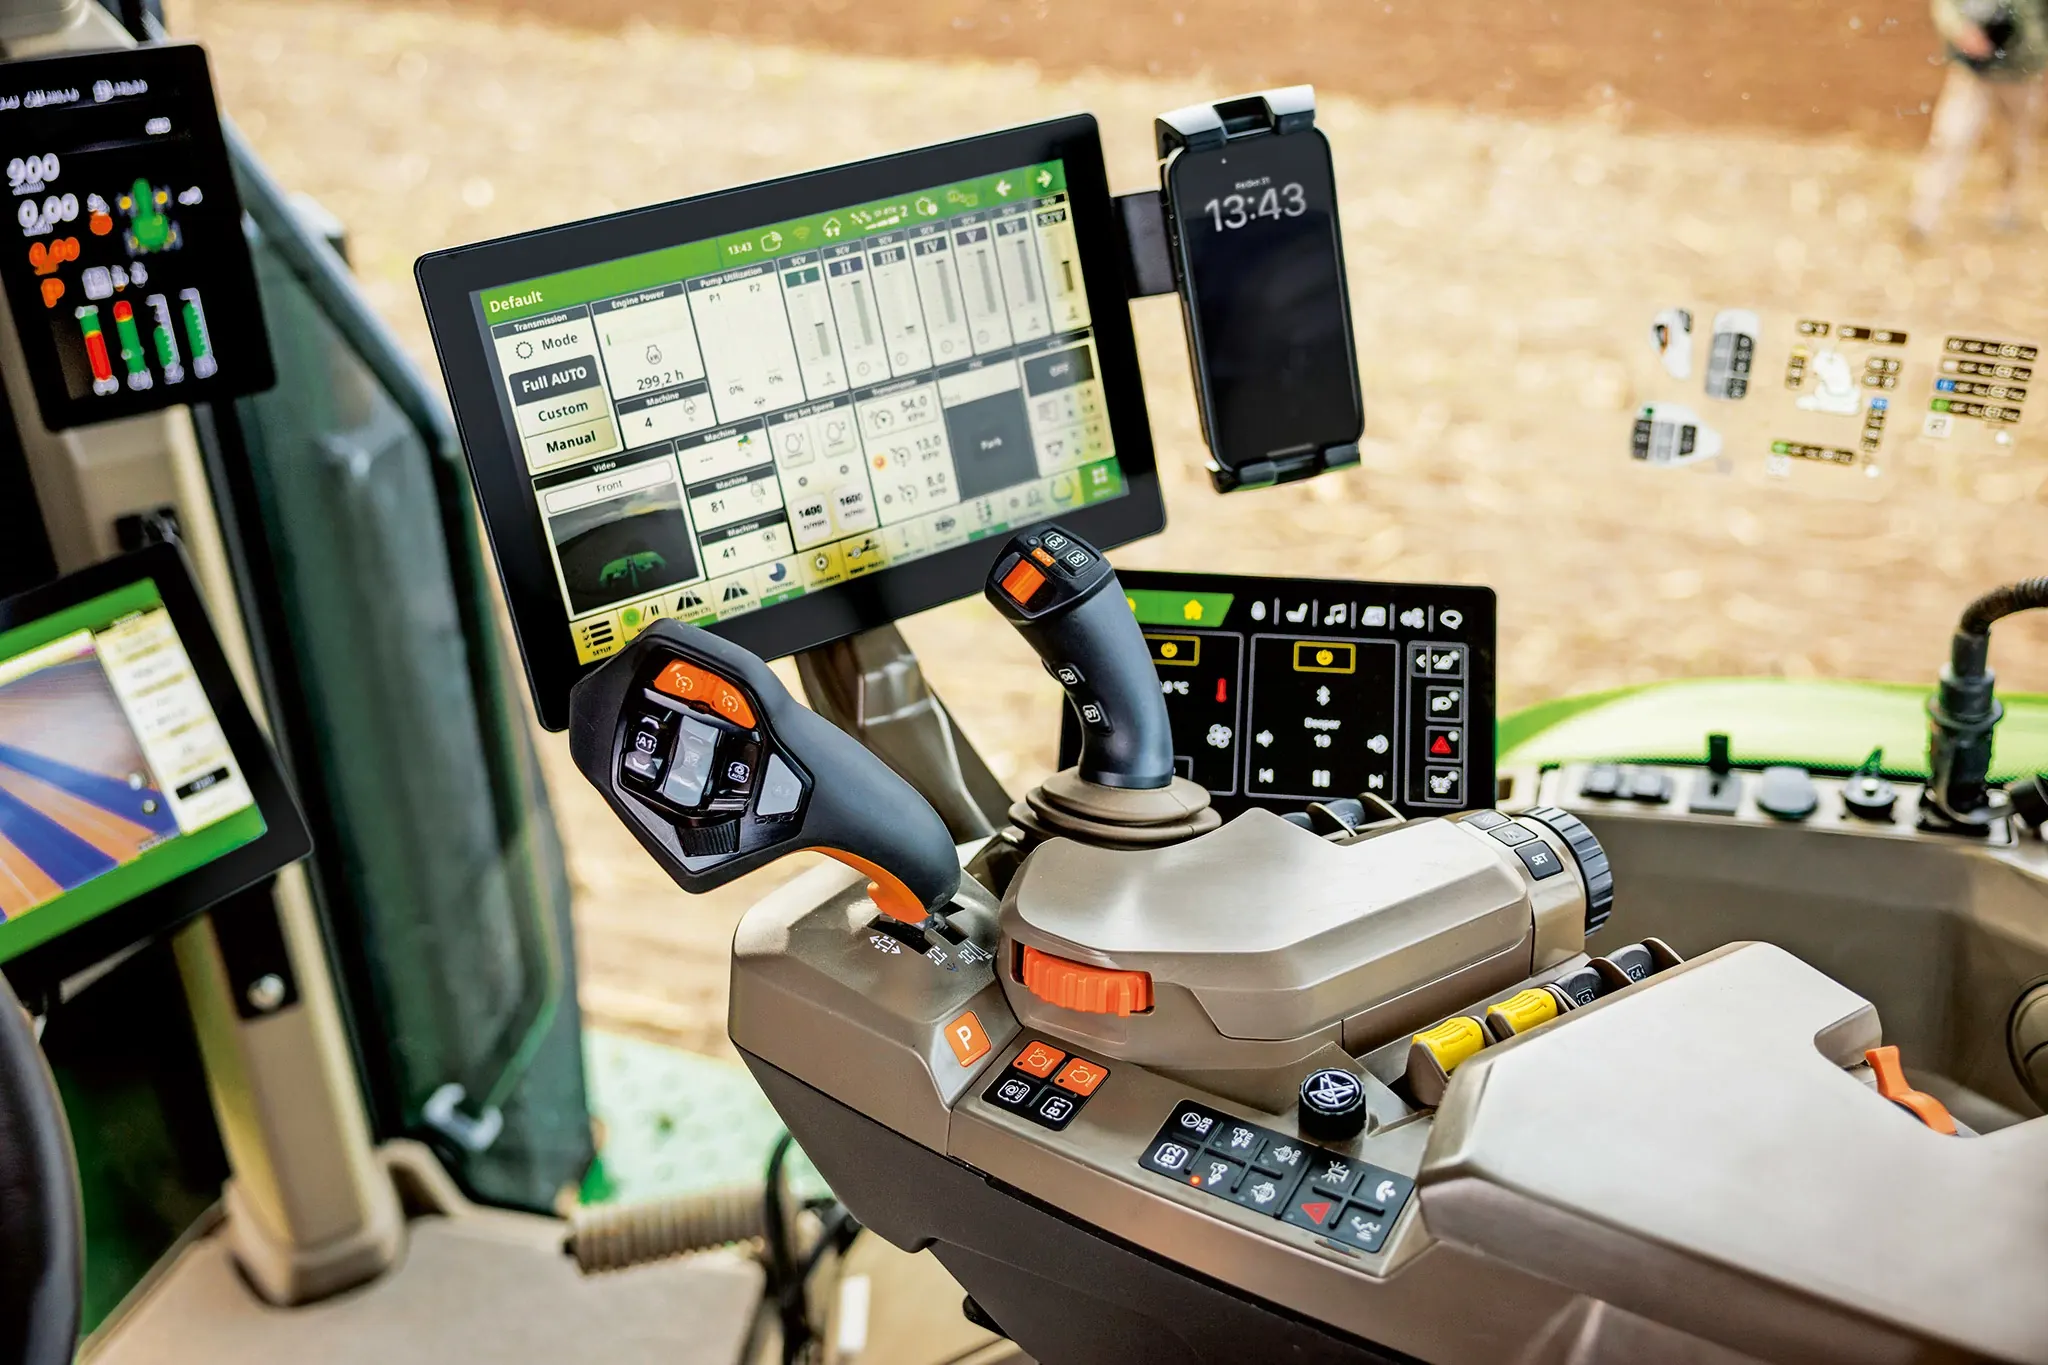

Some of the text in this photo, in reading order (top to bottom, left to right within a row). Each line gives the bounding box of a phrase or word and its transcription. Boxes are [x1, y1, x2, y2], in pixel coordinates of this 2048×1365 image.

[1204, 182, 1307, 232] 13:43
[728, 242, 753, 255] 13:43
[791, 256, 806, 266] SCV
[880, 249, 898, 264] III
[700, 265, 763, 288] Pump Utilization
[749, 282, 761, 293] P2
[489, 290, 543, 313] Default
[611, 289, 665, 311] Engine Power
[709, 292, 721, 304] P1
[514, 312, 567, 333] Transmission
[541, 332, 578, 351] Mode
[521, 366, 587, 394] Full AUTO
[637, 370, 684, 392] 299,2 h
[646, 390, 680, 407] Machine
[538, 401, 589, 423] Custom
[645, 417, 653, 428] 4
[546, 430, 597, 454] Manual
[704, 427, 737, 443] Machine
[592, 460, 616, 474] Video
[596, 479, 623, 493] Front
[715, 475, 748, 490] Machine
[711, 499, 726, 513] 81
[727, 522, 759, 537] Machine
[1049, 536, 1062, 549] D4
[723, 547, 736, 559] 41
[1070, 552, 1084, 566] D5
[592, 645, 613, 658] SETUP
[638, 737, 653, 750] A1
[1531, 853, 1549, 866] SET
[1630, 968, 1642, 980] C4
[1580, 993, 1593, 1005] C3
[956, 1025, 972, 1051] P
[1047, 1098, 1067, 1117] B1
[1240, 1132, 1255, 1148] AUTO
[1160, 1146, 1181, 1164] B2
